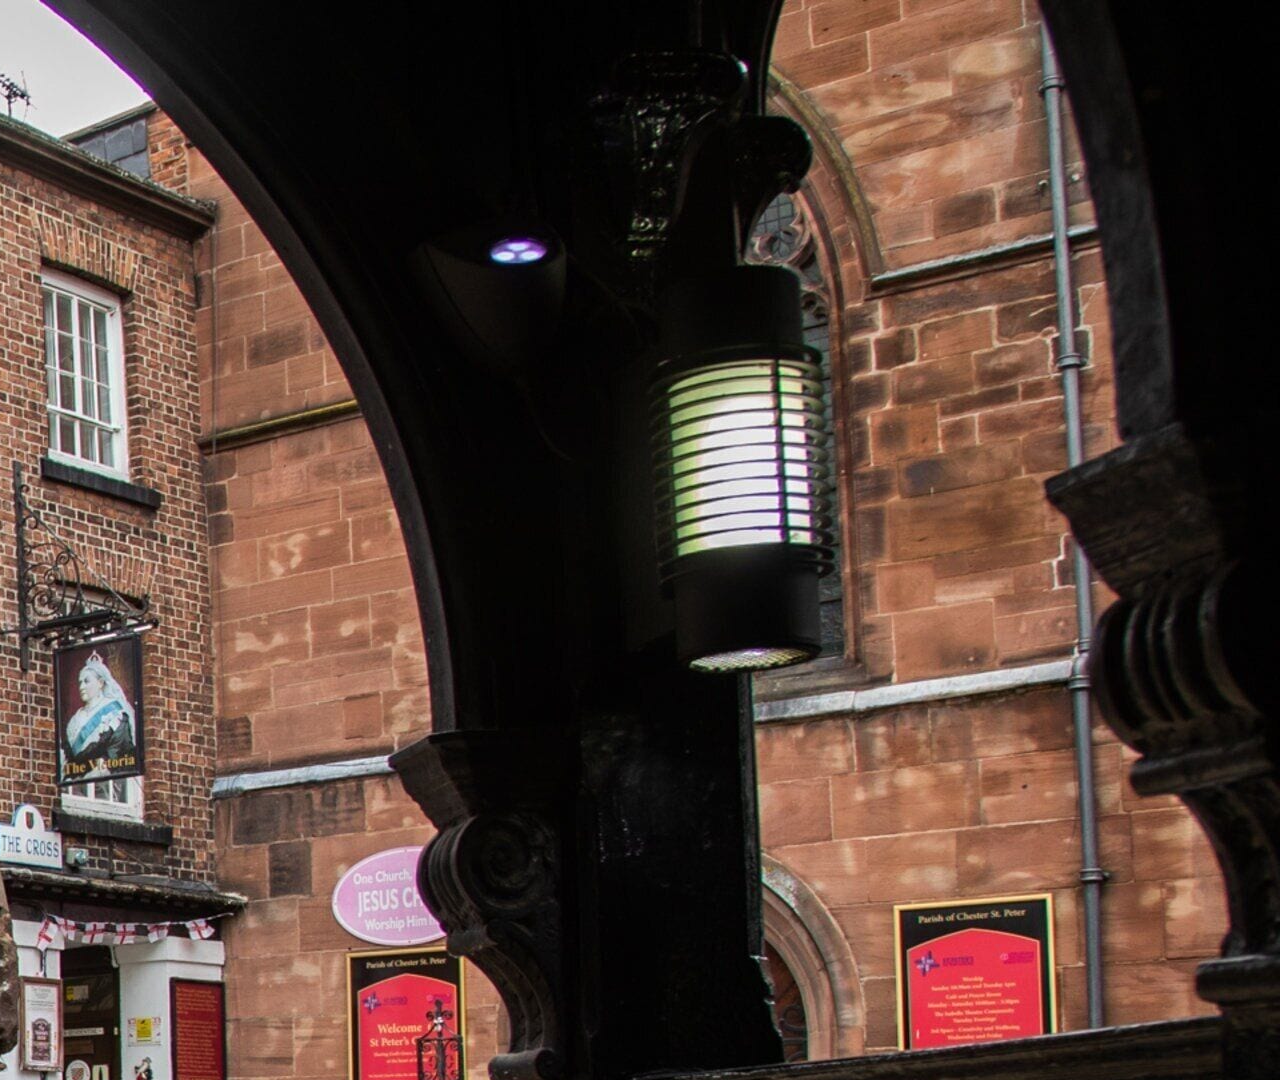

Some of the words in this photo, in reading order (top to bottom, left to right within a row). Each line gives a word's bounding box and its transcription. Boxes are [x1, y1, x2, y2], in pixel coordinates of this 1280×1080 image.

[64, 762, 86, 775] The
[89, 754, 136, 770] Vtoria
[1, 835, 22, 853] THE
[26, 839, 59, 858] CROSS
[353, 873, 373, 885] One
[358, 888, 399, 918] JESUS
[365, 917, 405, 932] Worship
[407, 916, 428, 928] Him
[918, 915, 944, 924] Parish
[945, 914, 955, 922] of
[956, 912, 989, 921] Chester
[1004, 908, 1027, 917] Peter
[366, 960, 385, 969] Parish
[387, 960, 394, 968] of
[395, 958, 418, 968] Chester
[430, 957, 446, 965] Peter
[378, 1023, 422, 1034] Welcome
[369, 1039, 379, 1047] St
[380, 1036, 410, 1047] Peter's
